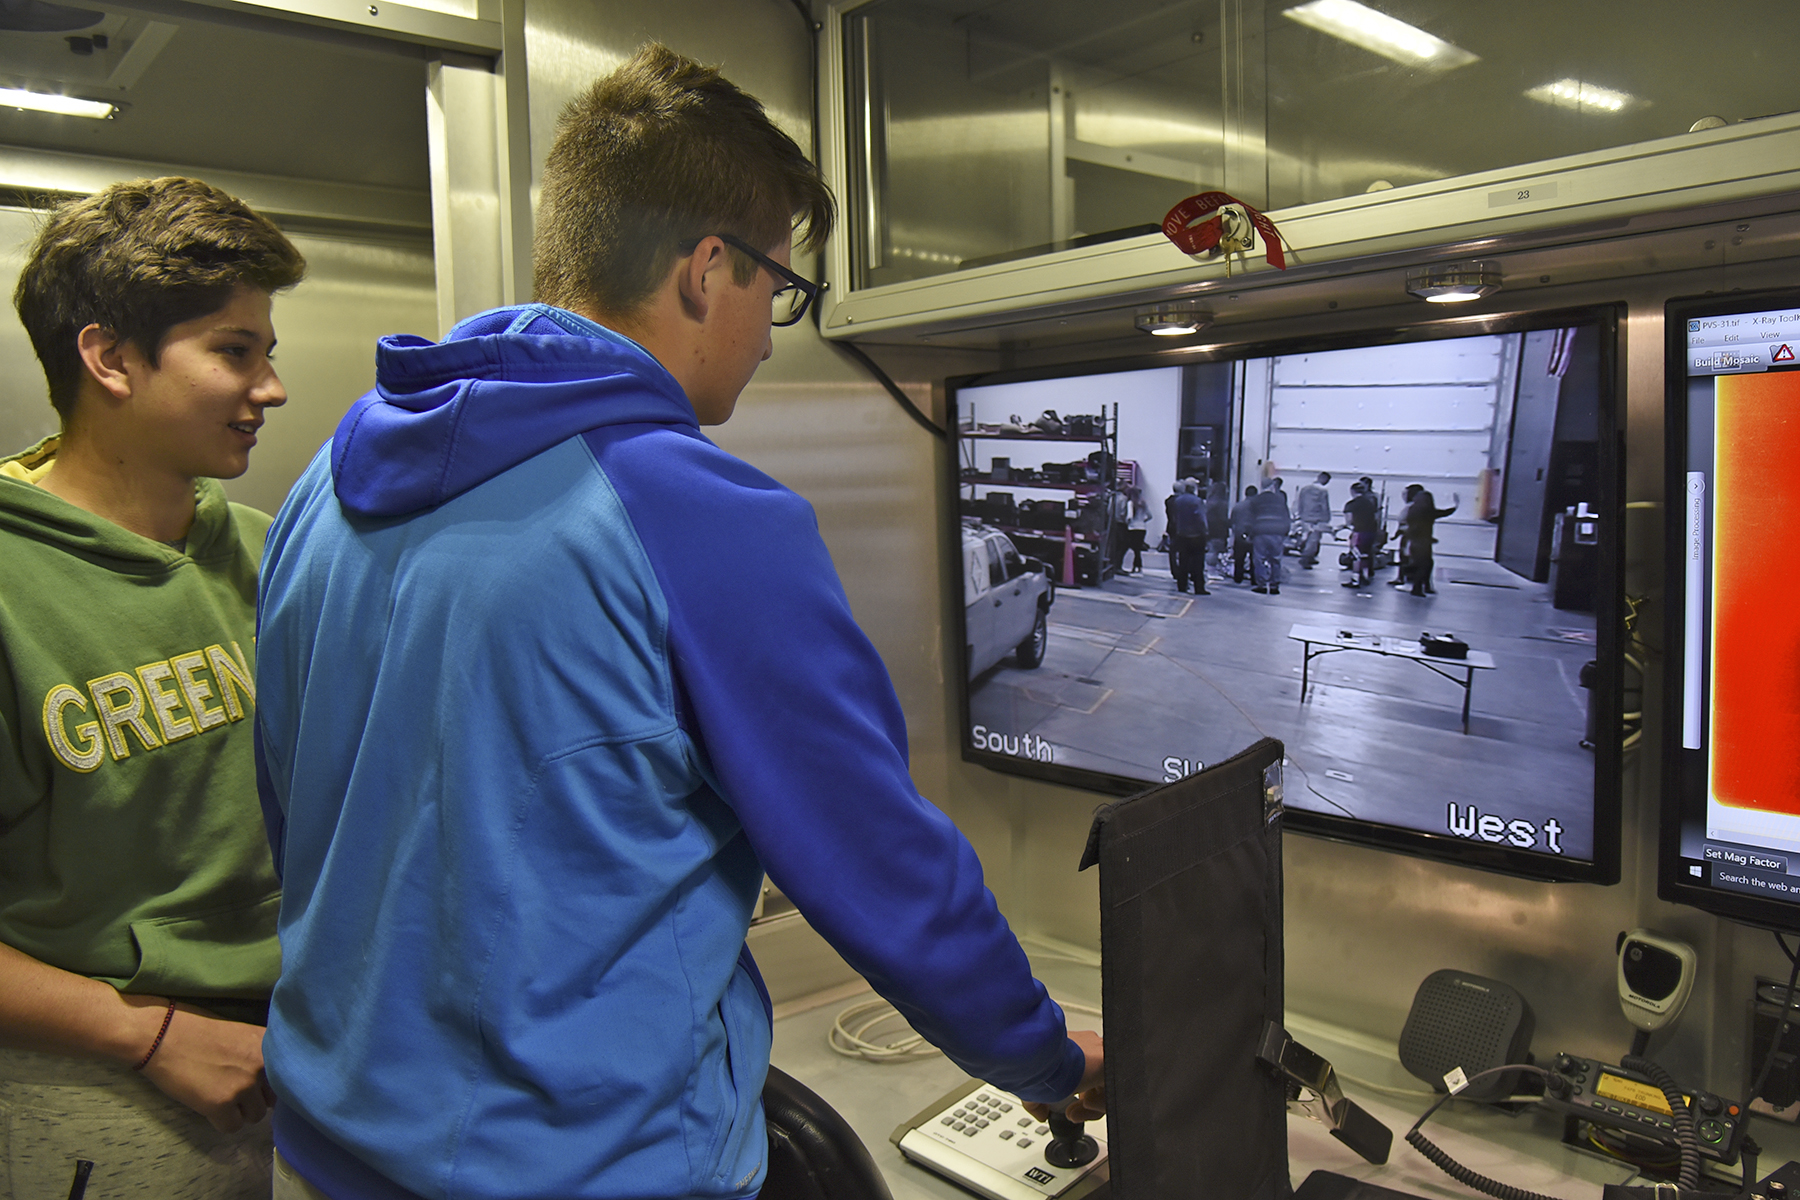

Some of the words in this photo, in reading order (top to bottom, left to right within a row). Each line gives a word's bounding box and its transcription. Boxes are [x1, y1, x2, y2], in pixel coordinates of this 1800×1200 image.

[1517, 190, 1530, 200] 23
[1702, 319, 1740, 329] PVS-31.tif
[1752, 316, 1777, 325] X-Ray
[1760, 331, 1780, 339] View
[1695, 356, 1720, 367] Build
[1723, 354, 1759, 366] Mosaic
[972, 724, 1054, 763] South
[1447, 801, 1564, 855] West
[1706, 848, 1722, 859] Set
[1724, 851, 1747, 866] Mag
[1749, 855, 1781, 869] Factor
[1719, 871, 1749, 885] Search
[1751, 877, 1767, 888] the
[1768, 881, 1788, 892] web
[1029, 1168, 1052, 1184] WTI
